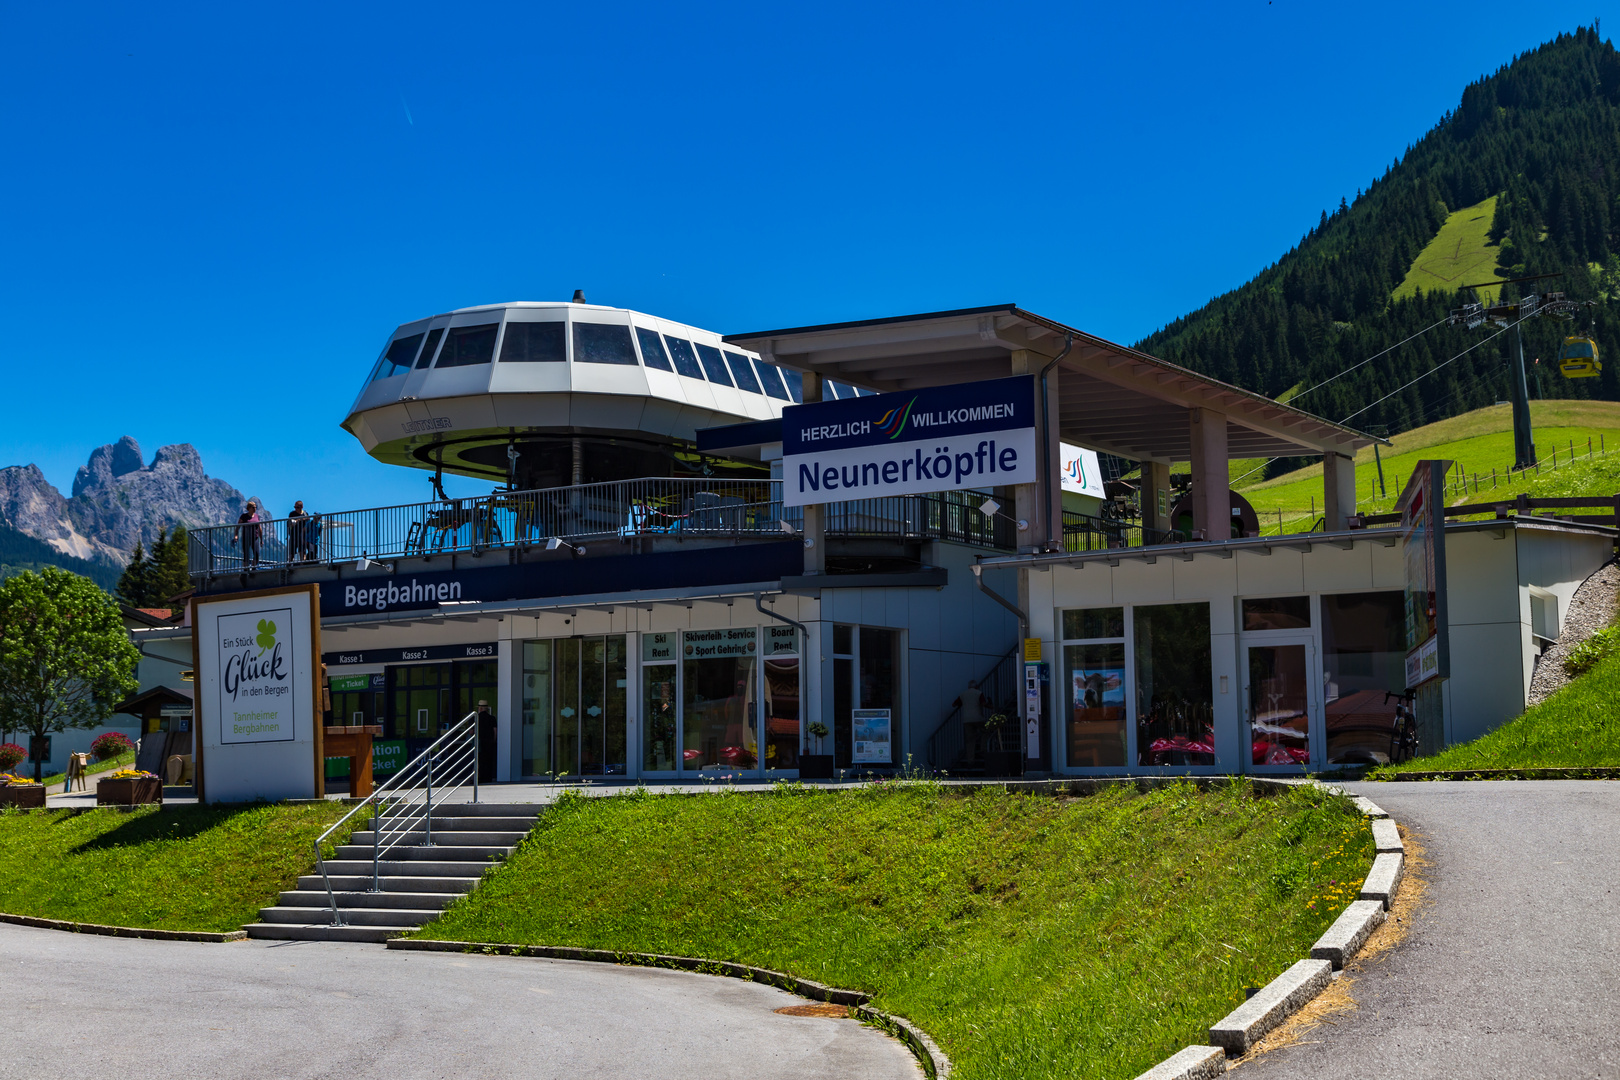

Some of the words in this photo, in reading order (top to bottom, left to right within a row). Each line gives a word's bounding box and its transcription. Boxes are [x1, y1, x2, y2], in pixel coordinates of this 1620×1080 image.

[401, 417, 452, 433] LEITNER
[801, 420, 871, 442] HERZLICH
[911, 403, 1015, 428] WILLKOMMEN
[799, 440, 1018, 493] Neunerköpfle
[344, 579, 462, 610] Bergbahnen
[654, 634, 667, 644] Ski
[685, 631, 722, 642] Skiverleih
[727, 629, 756, 640] Service
[771, 627, 795, 639] Board
[223, 638, 234, 648] Ein
[235, 636, 254, 647] Stück
[773, 641, 793, 650] Rent
[402, 652, 420, 661] Kasse
[421, 650, 428, 660] 2
[466, 647, 485, 656] Kasse
[486, 645, 493, 655] 3
[652, 647, 670, 658] Rent
[695, 645, 716, 656] Sport
[717, 643, 747, 656] Gehring
[340, 655, 357, 664] Kasse
[358, 654, 364, 663] 1
[224, 641, 288, 703] Glück
[347, 679, 364, 688] Ticket
[241, 687, 248, 696] in
[250, 687, 263, 696] den
[264, 685, 289, 698] Bergen
[233, 710, 278, 722] Tannheimer
[233, 723, 280, 736] Bergbahnen
